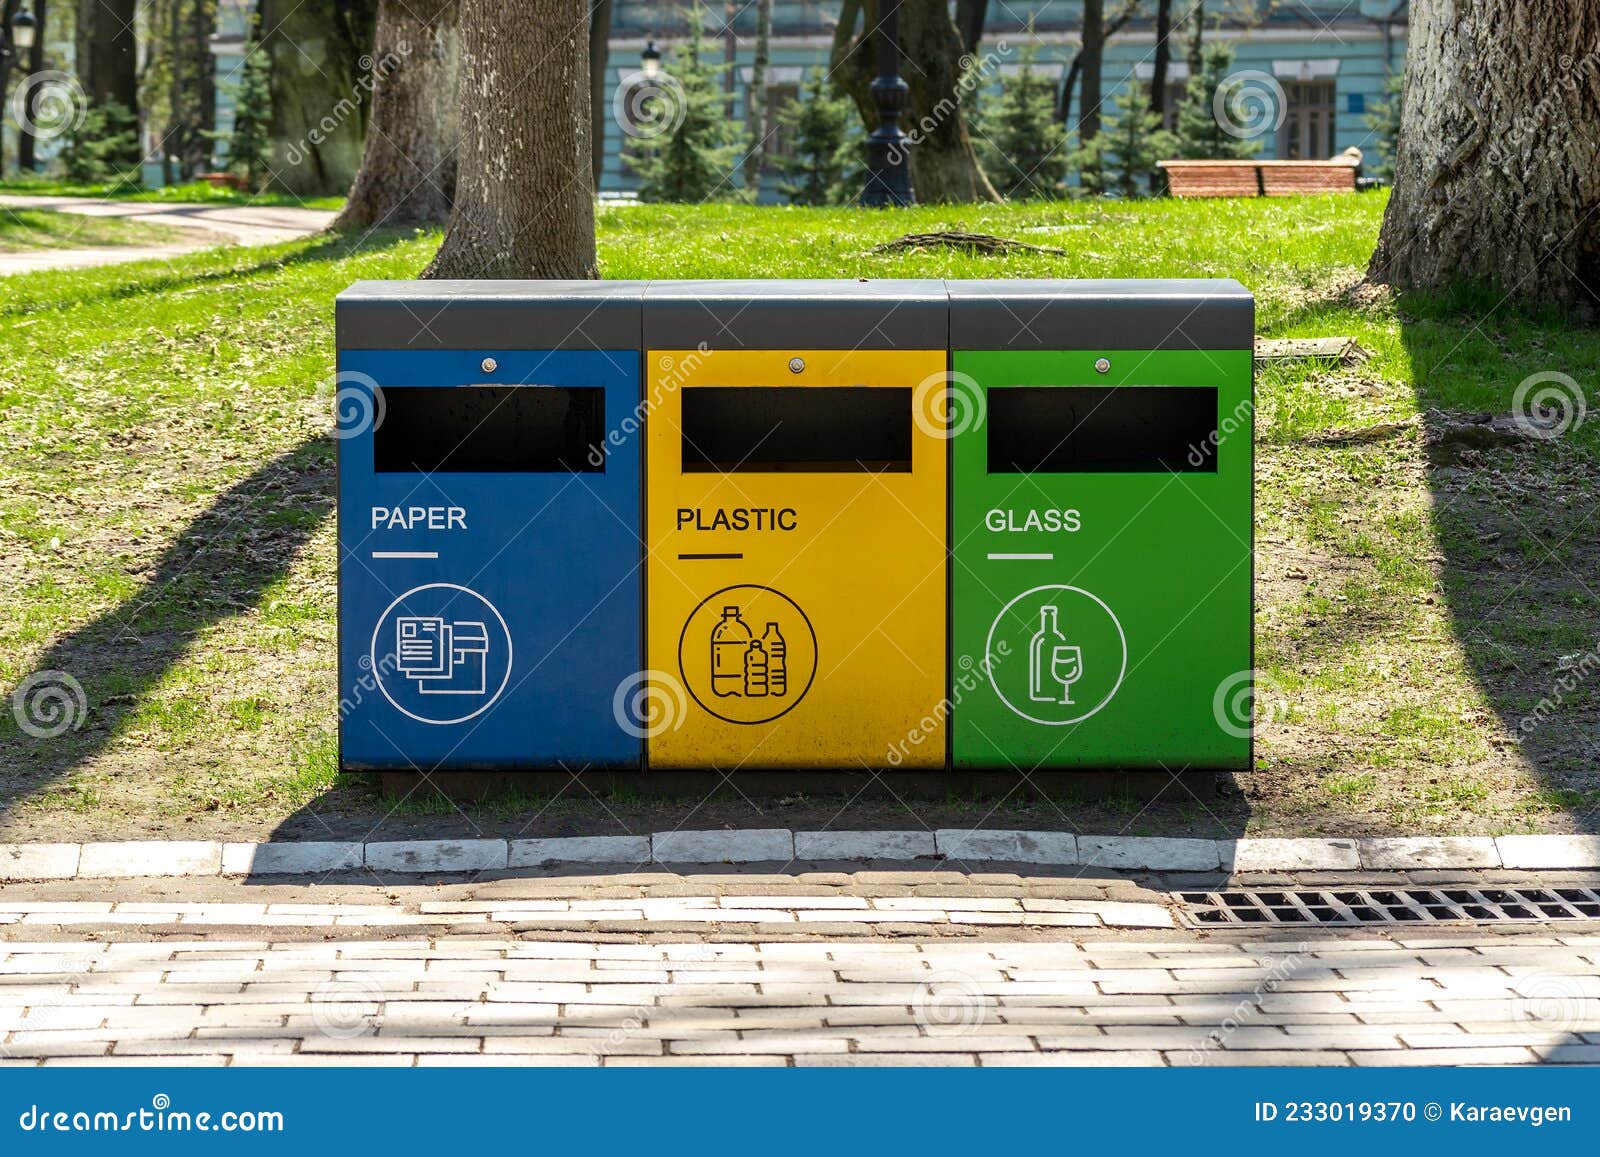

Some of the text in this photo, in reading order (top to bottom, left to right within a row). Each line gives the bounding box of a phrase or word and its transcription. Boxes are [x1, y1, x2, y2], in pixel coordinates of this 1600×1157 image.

[371, 507, 468, 530] PAPER
[677, 508, 797, 532] PLASTIC
[985, 508, 1081, 532] GLASS
